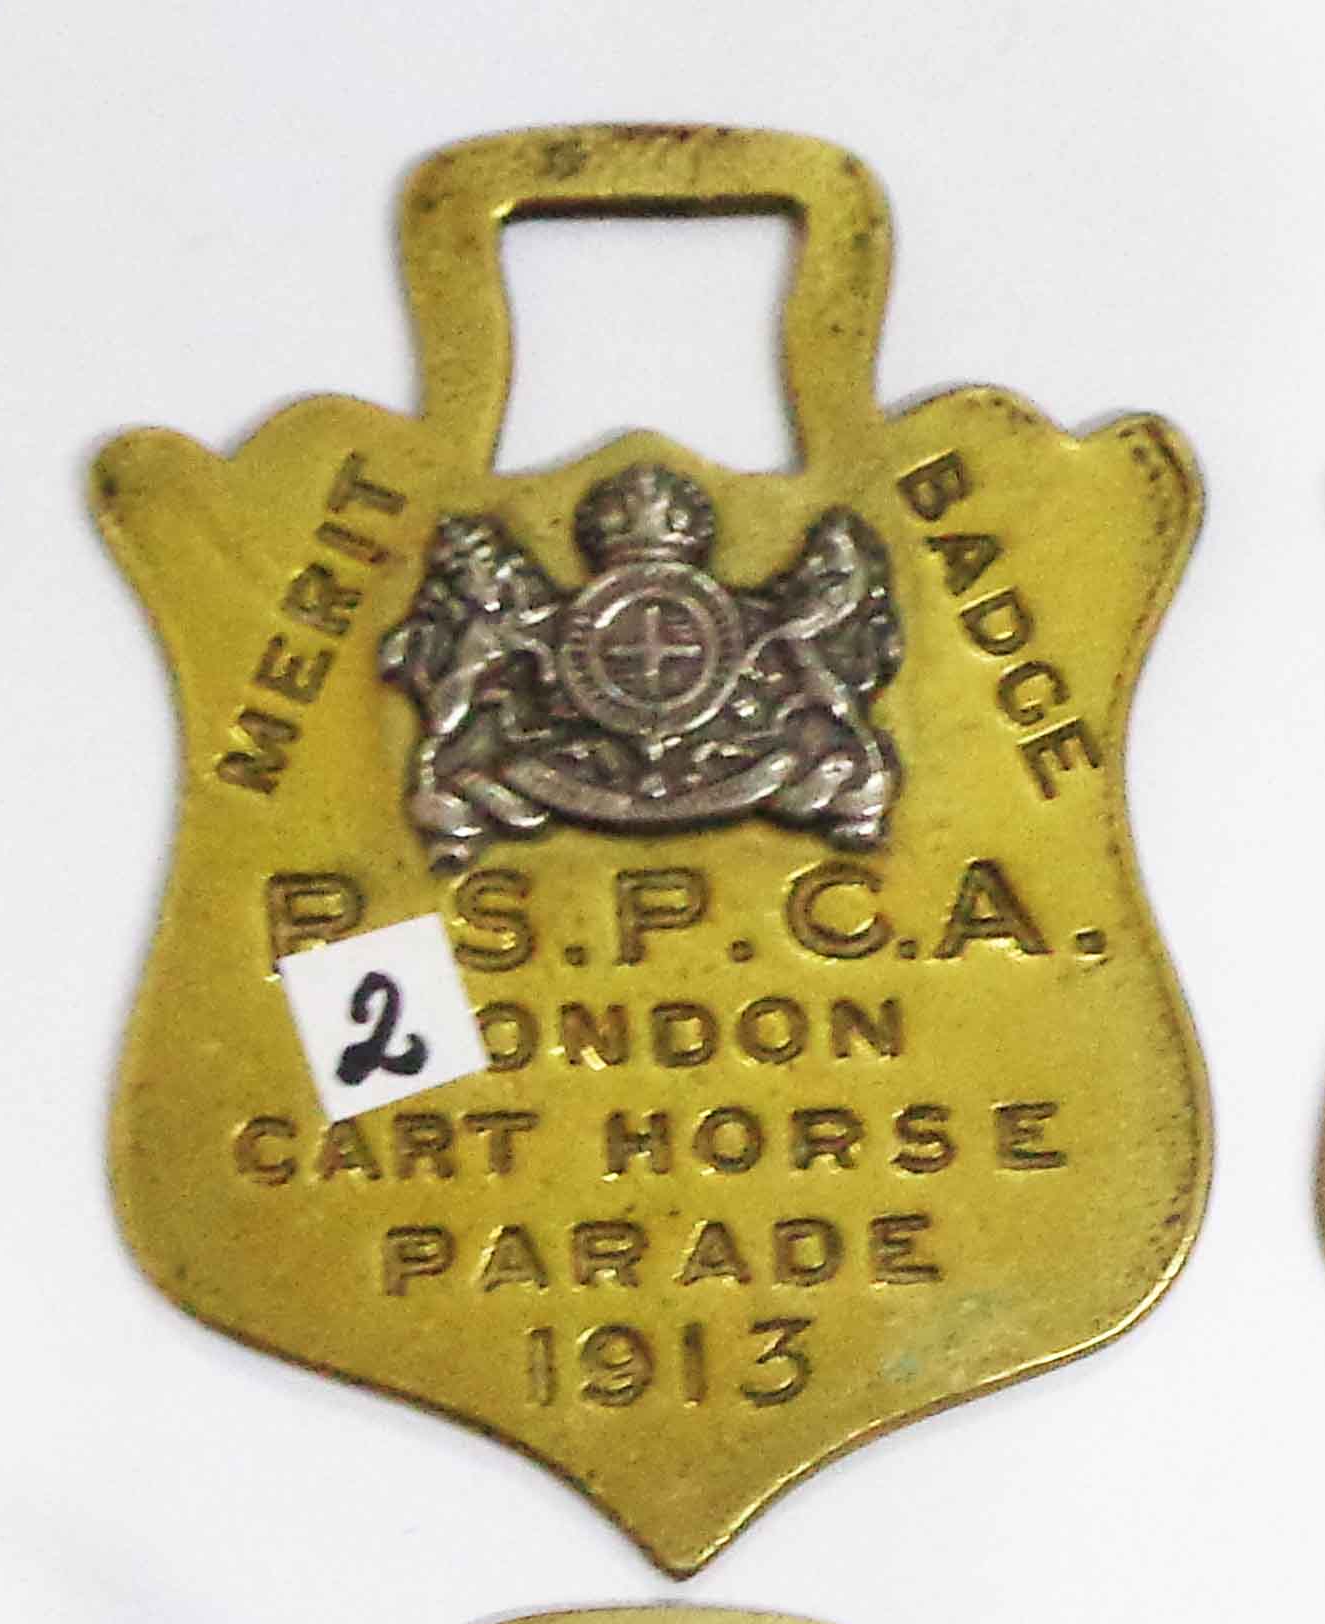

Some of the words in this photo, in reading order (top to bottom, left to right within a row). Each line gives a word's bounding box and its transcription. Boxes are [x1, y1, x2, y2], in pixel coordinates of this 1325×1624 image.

[220, 452, 410, 794] MERIT
[897, 449, 1101, 803] BADGE
[334, 969, 429, 1086] 2
[475, 995, 906, 1073] ONDON
[232, 1109, 542, 1187] CART
[601, 1101, 1070, 1178] HORSE
[384, 1213, 944, 1295] PARADE
[523, 1317, 815, 1410] 1913
